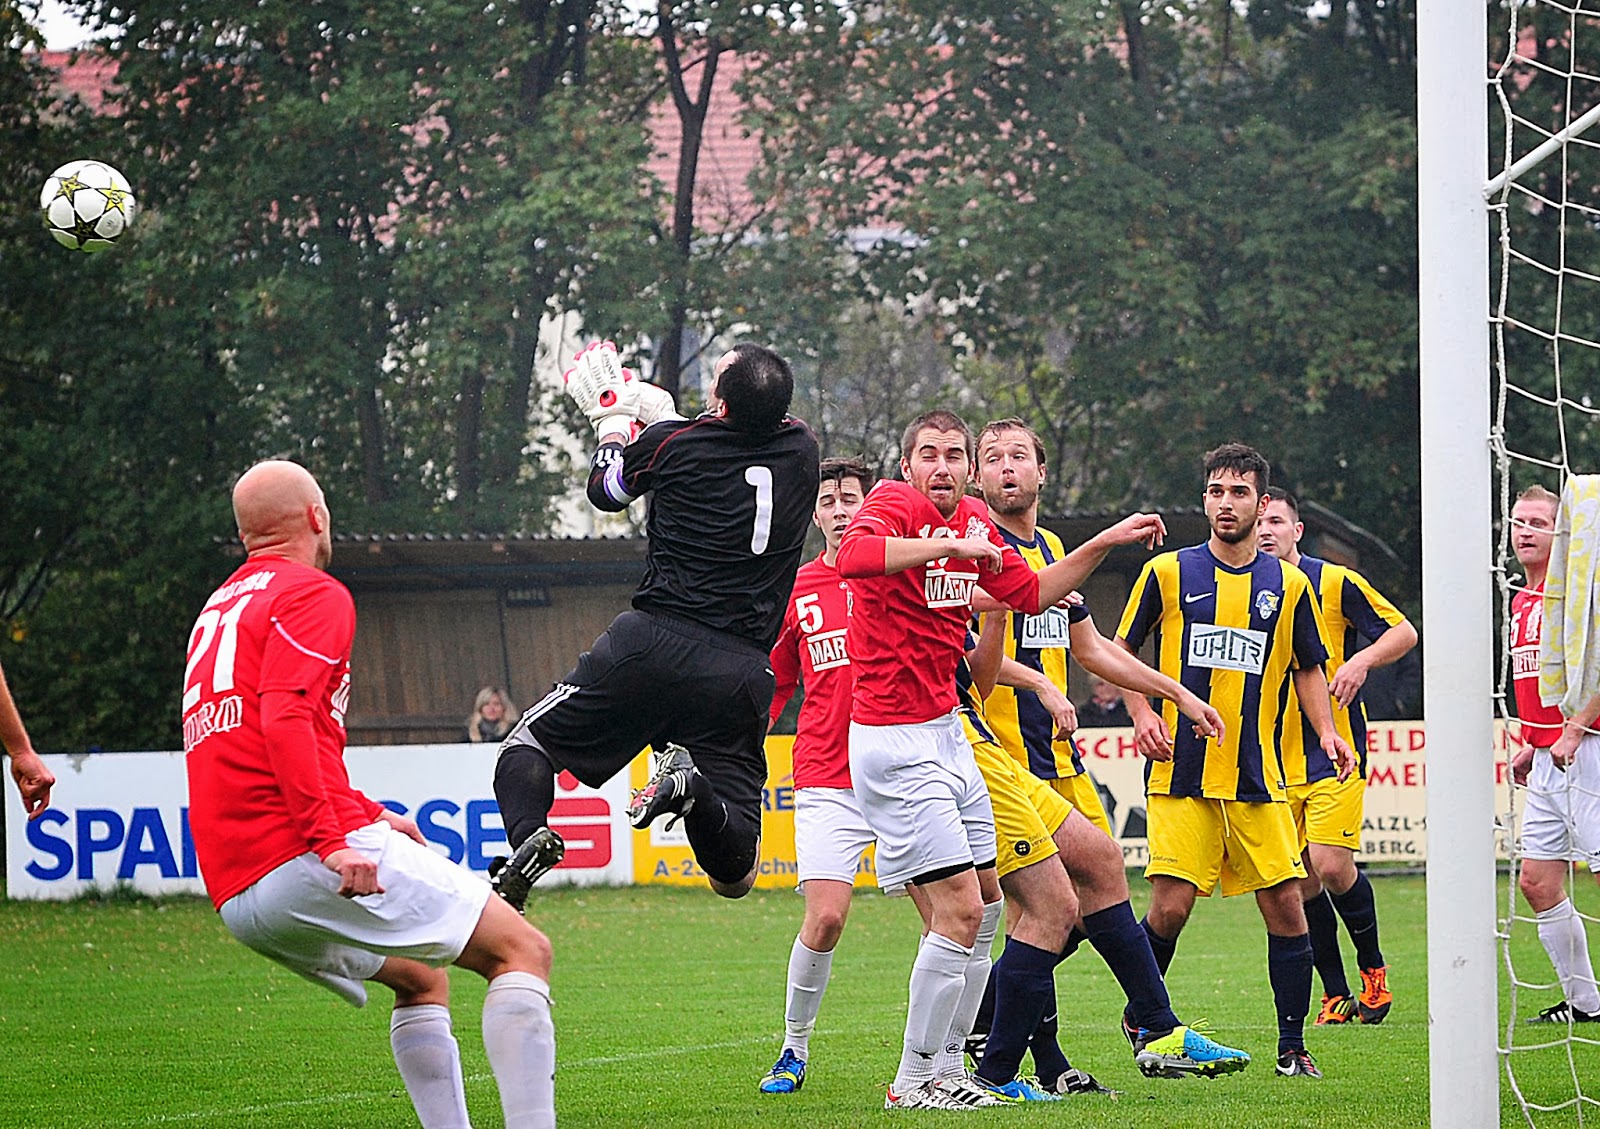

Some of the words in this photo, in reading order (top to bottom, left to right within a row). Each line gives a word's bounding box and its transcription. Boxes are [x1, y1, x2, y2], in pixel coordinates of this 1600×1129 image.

[745, 466, 773, 555] 1
[795, 592, 824, 634] 5
[183, 594, 253, 715] 21
[808, 637, 848, 666] MAR
[654, 859, 707, 877] A-2
